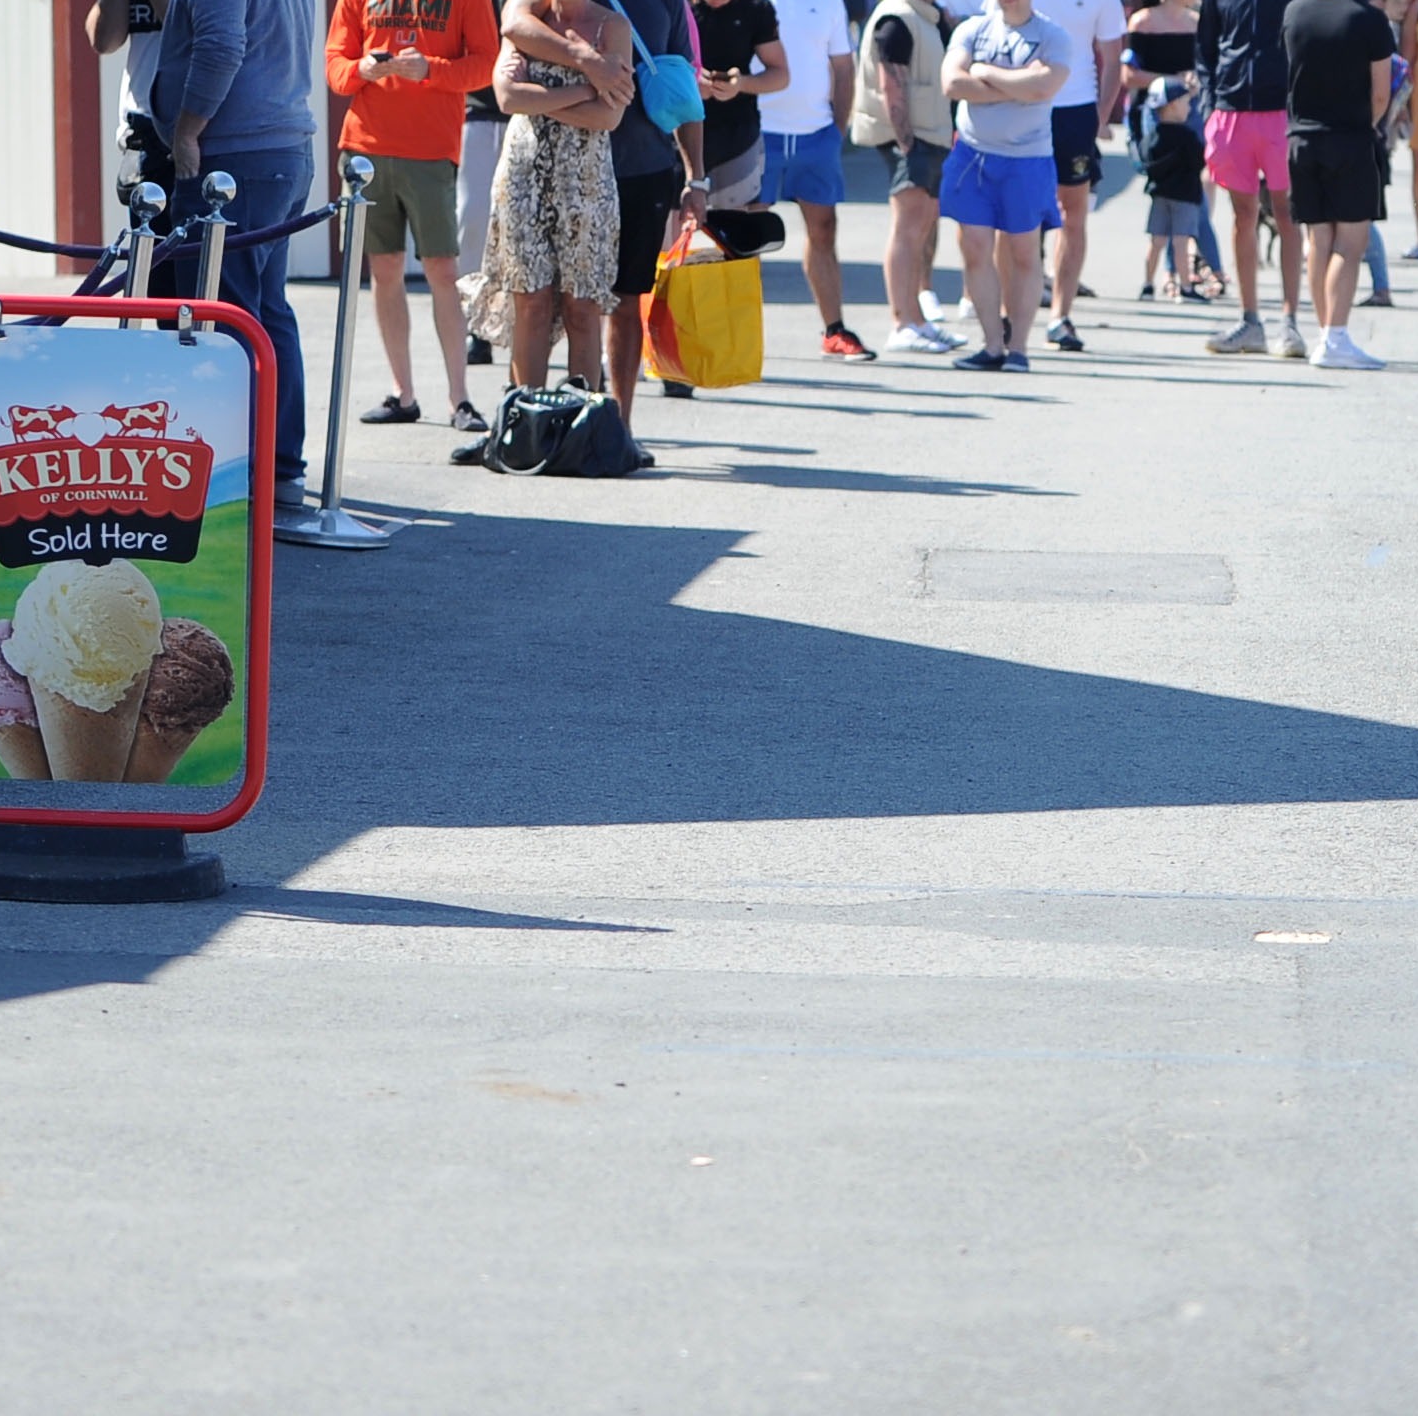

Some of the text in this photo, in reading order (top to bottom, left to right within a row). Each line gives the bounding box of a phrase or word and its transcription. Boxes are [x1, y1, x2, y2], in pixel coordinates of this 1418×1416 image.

[39, 488, 149, 505] OF CORNWALL
[28, 521, 169, 556] Sold Here
